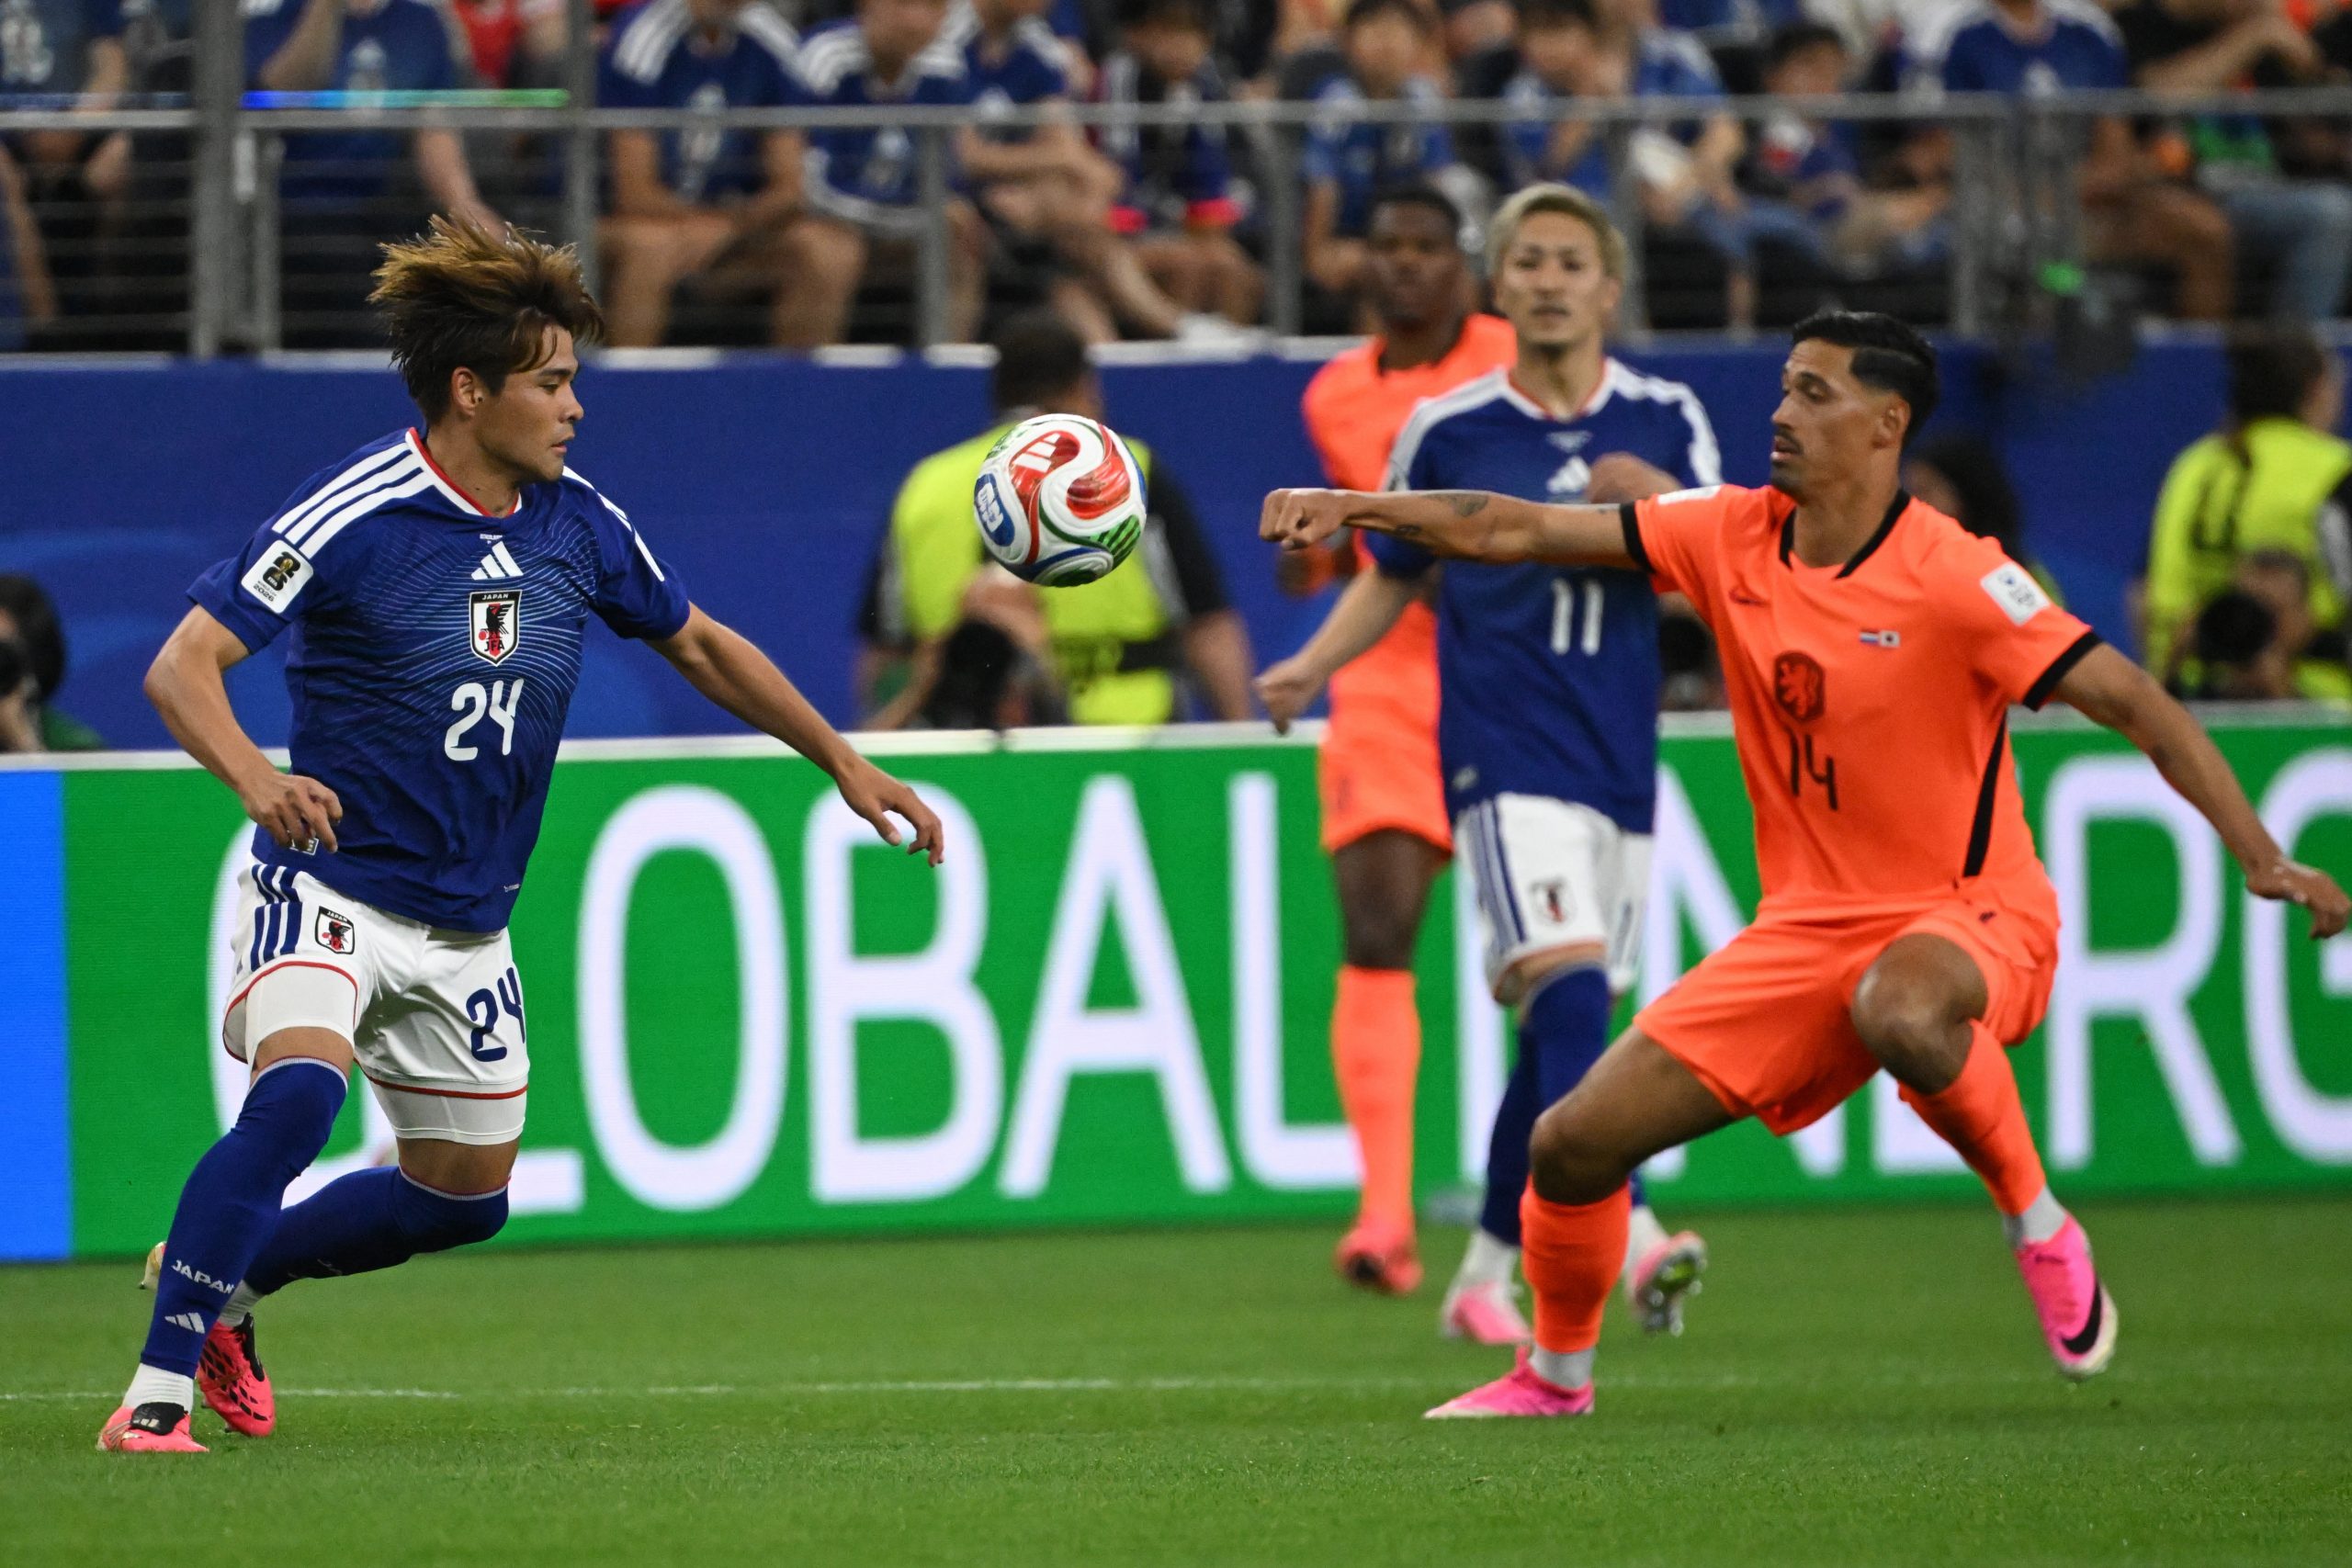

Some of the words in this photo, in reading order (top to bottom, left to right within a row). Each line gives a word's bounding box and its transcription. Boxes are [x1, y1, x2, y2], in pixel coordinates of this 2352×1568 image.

[253, 583, 275, 603] 2026
[481, 593, 509, 602] JAPAN
[1551, 578, 1604, 656] 11
[484, 639, 505, 652] JFA
[445, 679, 525, 761] 24
[1786, 726, 1838, 810] 14
[326, 911, 348, 922] JAPAN
[208, 772, 1360, 1214] OBAL
[466, 967, 525, 1062] 24
[171, 1258, 235, 1294] JAPAN
